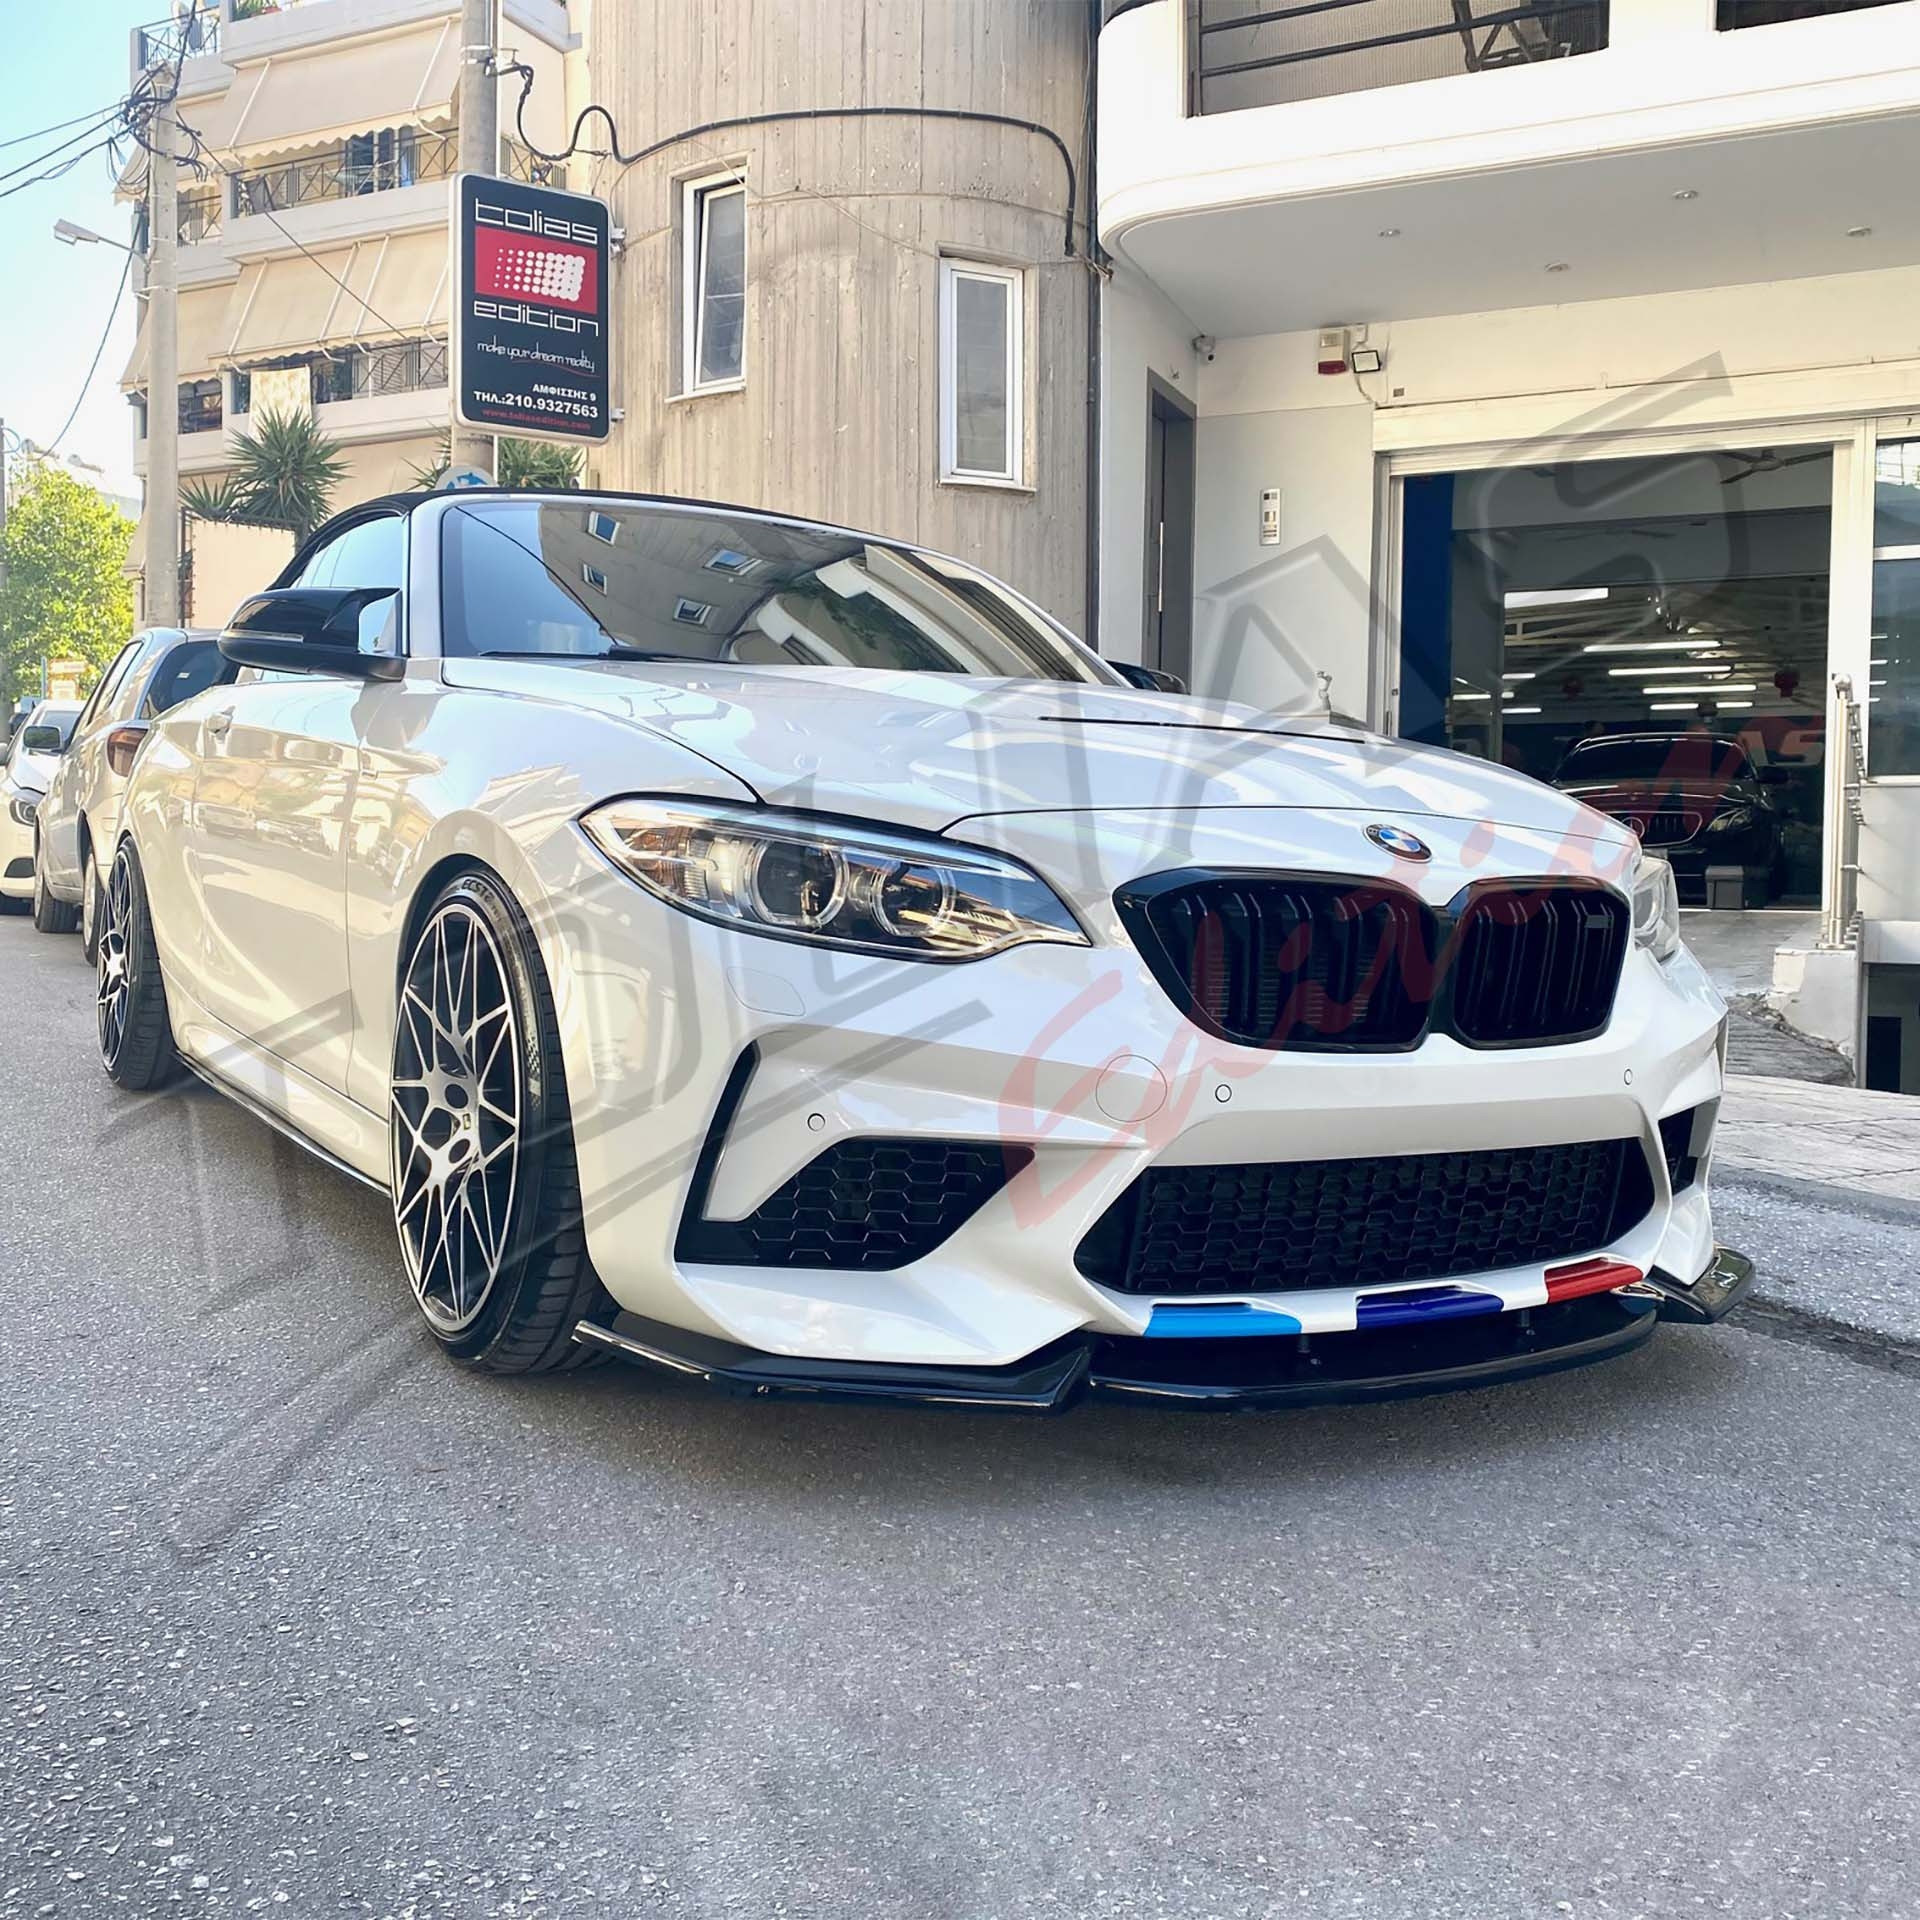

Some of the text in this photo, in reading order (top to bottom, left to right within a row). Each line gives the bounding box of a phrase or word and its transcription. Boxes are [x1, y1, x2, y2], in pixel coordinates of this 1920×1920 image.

[474, 198, 598, 245] tolias
[473, 300, 599, 337] edition
[477, 335, 595, 373] make your dream reality
[589, 393, 597, 402] 9
